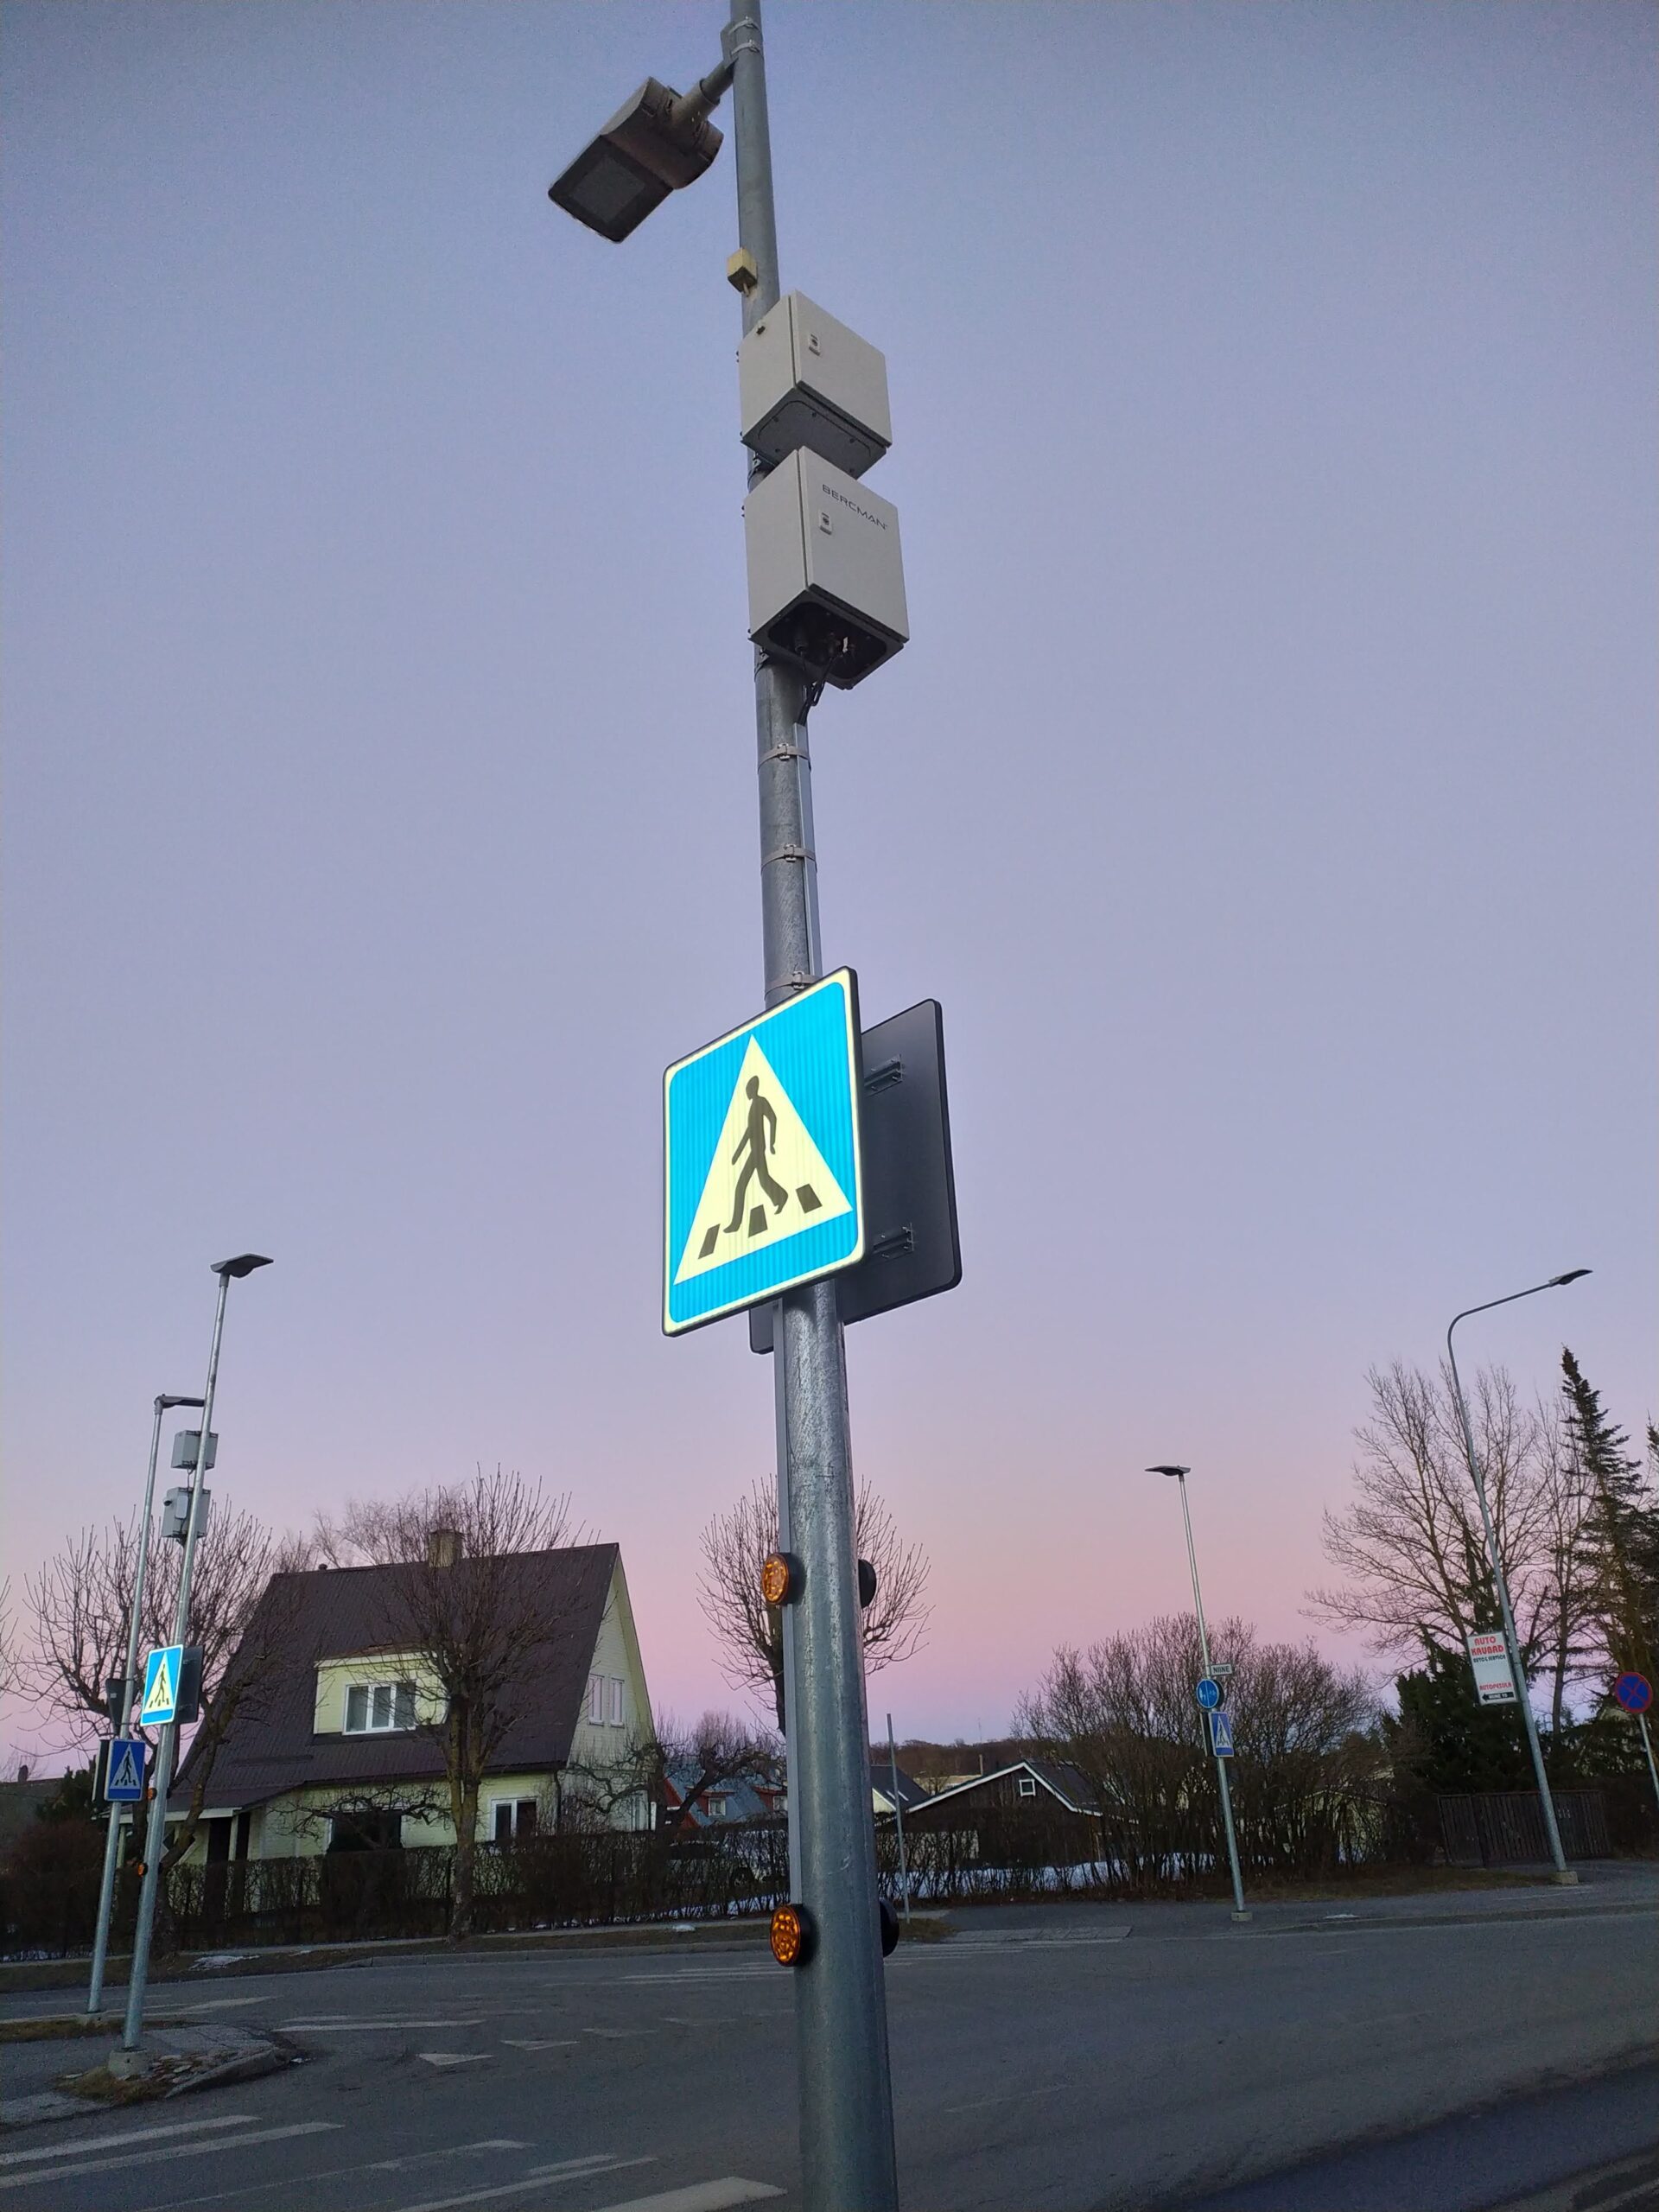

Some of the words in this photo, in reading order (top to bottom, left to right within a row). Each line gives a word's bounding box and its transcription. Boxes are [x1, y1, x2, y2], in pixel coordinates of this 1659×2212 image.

[822, 484, 887, 531] BERCMAN
[1474, 1636, 1496, 1645] AUTO
[1471, 1645, 1503, 1656] KAUBAD
